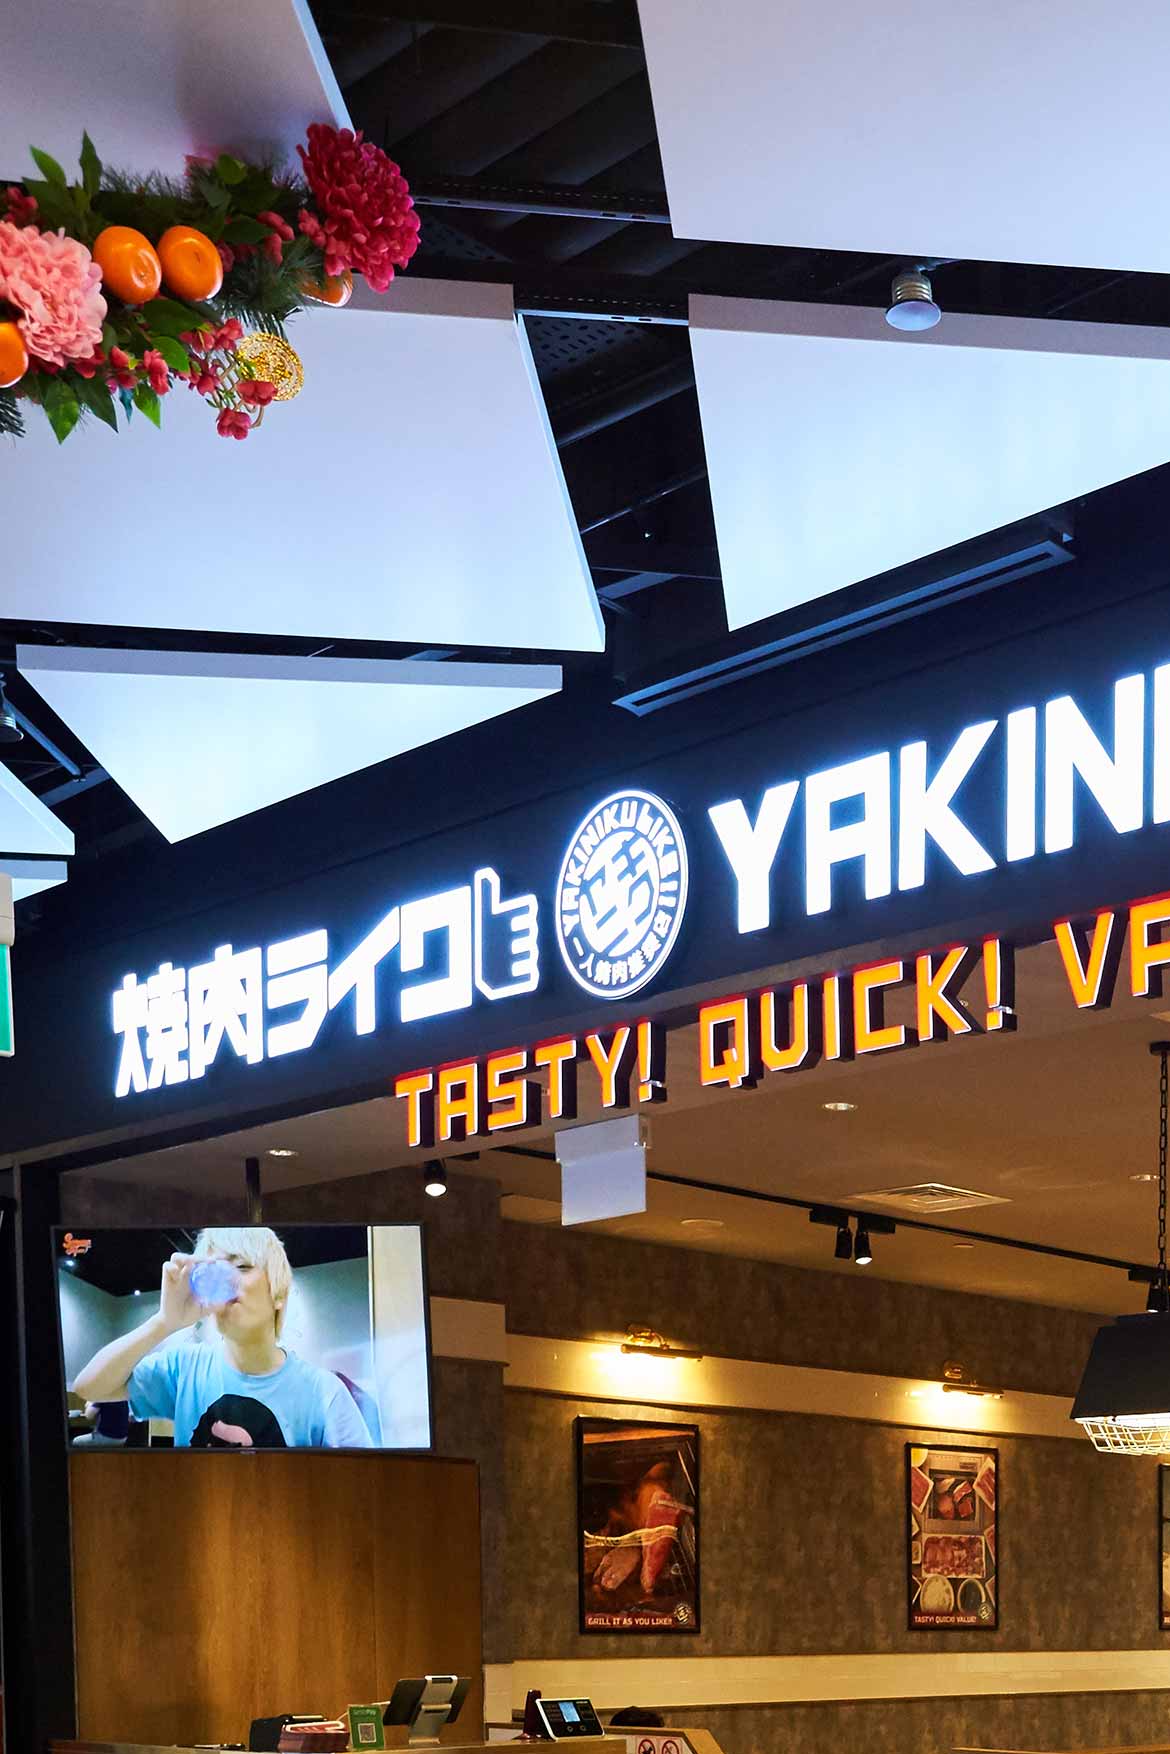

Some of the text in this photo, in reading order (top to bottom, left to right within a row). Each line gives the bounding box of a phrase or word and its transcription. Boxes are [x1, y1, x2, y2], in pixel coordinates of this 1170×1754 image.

[562, 801, 637, 936] YAKINIKU
[395, 1020, 654, 1147] TASTY!
[698, 939, 1010, 1087] QUICK!
[588, 1617, 610, 1625] GRILL
[613, 1617, 620, 1625] IT
[622, 1617, 633, 1625] AS
[634, 1617, 650, 1625] YOU
